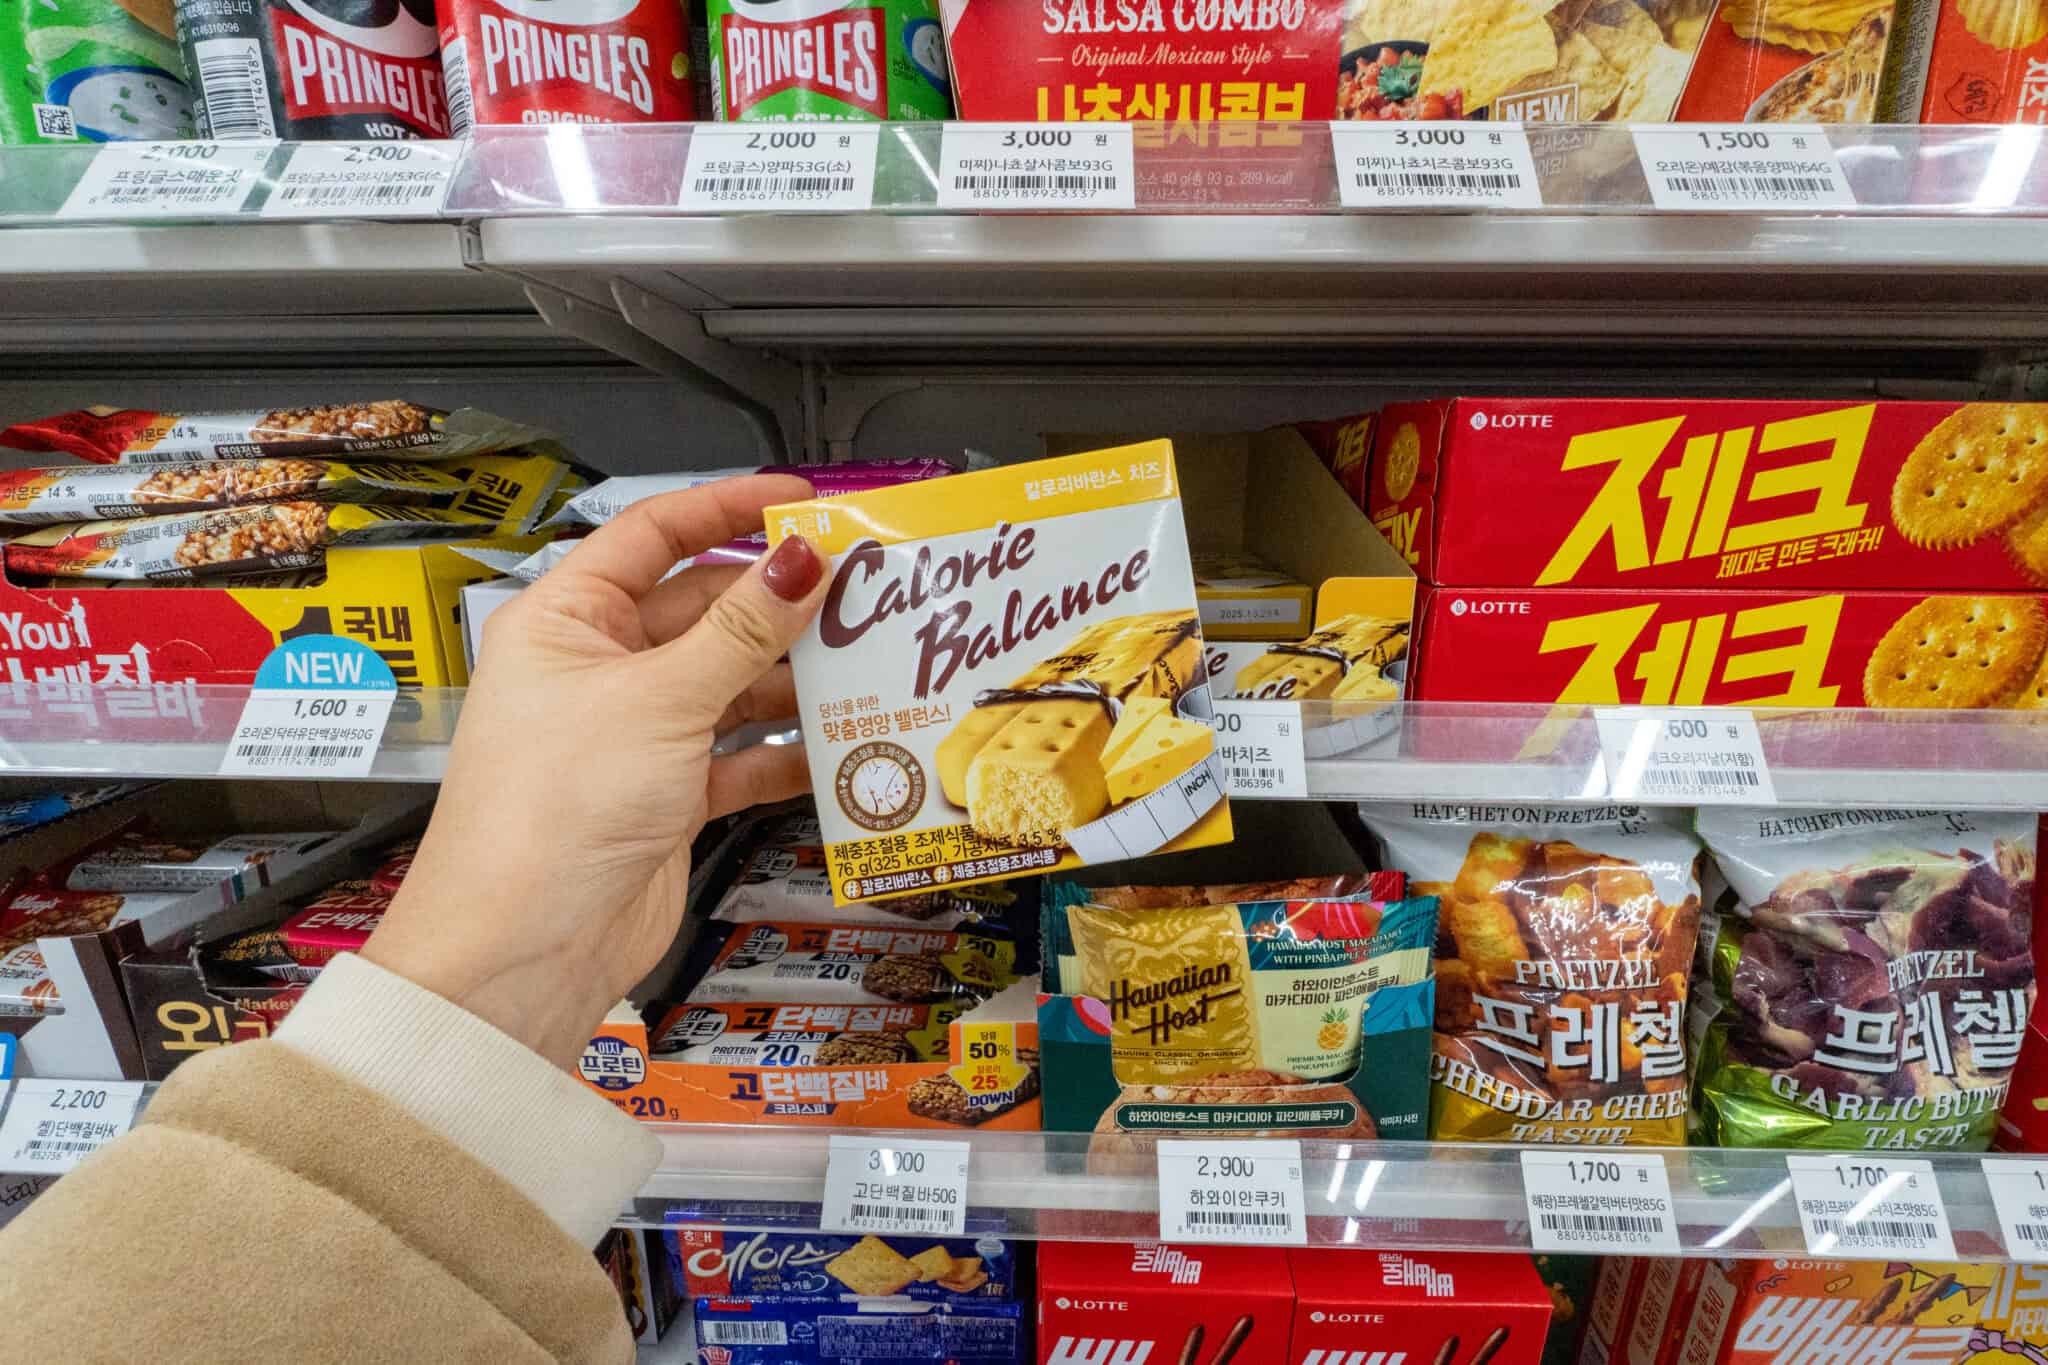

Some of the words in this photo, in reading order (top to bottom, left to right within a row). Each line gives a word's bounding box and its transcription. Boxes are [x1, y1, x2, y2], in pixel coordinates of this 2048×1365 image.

[1043, 0, 1164, 34] SALSA
[1174, 0, 1303, 32] COMBO
[480, 14, 653, 114] PRINGLES
[727, 20, 878, 107] PRINGLES
[1071, 43, 1144, 77] Original
[1145, 43, 1225, 66] Mexican
[1231, 43, 1272, 75] Style
[1506, 95, 1570, 124] NEW
[746, 132, 816, 150] 2,000
[1001, 131, 1073, 149] 3,000
[1395, 129, 1466, 147] 3,000
[1698, 132, 1770, 150] 1,500
[344, 146, 412, 163] 2,000
[1491, 414, 1553, 428] LOTTE
[172, 427, 183, 440] 14
[189, 426, 199, 439] %
[477, 472, 522, 498] 국내
[1024, 468, 1124, 500] 칼로리바란스
[1129, 460, 1162, 483] 치즈
[48, 486, 60, 499] 14
[66, 486, 76, 498] %
[1533, 403, 1877, 586] 제크
[1715, 546, 1775, 578] 제대로
[1777, 539, 1817, 569] 만든
[1818, 526, 1884, 561] 크래커!
[819, 522, 1036, 648] Calorie
[1470, 601, 1531, 615] LOTTE
[343, 606, 412, 642] 국내
[914, 549, 1150, 699] Balance
[285, 652, 364, 684] NEW
[1525, 595, 1844, 725] 제크
[293, 699, 346, 719] 1,600
[819, 698, 854, 719] 당신을
[856, 695, 881, 712] 위한
[823, 712, 891, 743] 맞춤영양
[894, 703, 952, 732] 밸런스!
[1277, 721, 1290, 737] 원
[1216, 746, 1273, 764] 바치즈
[1184, 770, 1211, 797] INCH
[1233, 778, 1273, 790] 306396
[834, 834, 908, 860] 체중조절용
[914, 823, 977, 845] 조제식품
[1048, 827, 1062, 843] %
[835, 861, 854, 878] 76
[859, 855, 901, 876] g(325
[800, 929, 948, 955] 고단백질바
[777, 963, 816, 971] PROTEIN
[817, 963, 851, 980] 20
[1273, 955, 1302, 965] WITH
[1887, 949, 1985, 993] PRETZEL
[1292, 966, 1379, 992] 하와이안호스트
[1514, 959, 1660, 991] PRETZEL
[1103, 963, 1231, 1022] Hawaiian
[1265, 993, 1330, 1007] 마카다미아
[731, 1004, 915, 1032] 고단백질바
[765, 1031, 828, 1043] 크리스피
[1471, 992, 1687, 1083] 프레첼
[1813, 988, 2028, 1075] 프레첼
[598, 1041, 621, 1055] 이지
[712, 1047, 760, 1056] PROTEIN
[760, 1043, 801, 1066] 20
[583, 1056, 642, 1075] 프로틴
[729, 1070, 888, 1103] 고단백질바
[1429, 1052, 1593, 1121] CHEDDAR
[1771, 1074, 1926, 1122] GARLIC
[51, 1088, 107, 1110] 2,200
[630, 1096, 666, 1117] 20
[669, 1107, 680, 1121] g
[774, 1103, 827, 1114] 크리스피
[968, 1092, 1014, 1108] DOWN
[1128, 1110, 1209, 1124] 하와이안호스트
[1213, 1110, 1272, 1124] 마카다미아
[1276, 1107, 1344, 1122] 파인애플쿠키
[1511, 1124, 1632, 1145] TASTE
[1864, 1122, 1970, 1150] TASTE
[1198, 1155, 1254, 1178] 2,900
[1568, 1160, 1621, 1184] 1,700
[852, 1182, 957, 1204] 고단백질바50G
[1190, 1190, 1285, 1208] 하와이안쿠키
[687, 1232, 841, 1281] 에이스
[1791, 1261, 1848, 1271] LOTTE
[1074, 1300, 1129, 1311] LOTTE
[1328, 1313, 1385, 1324] LOTTE
